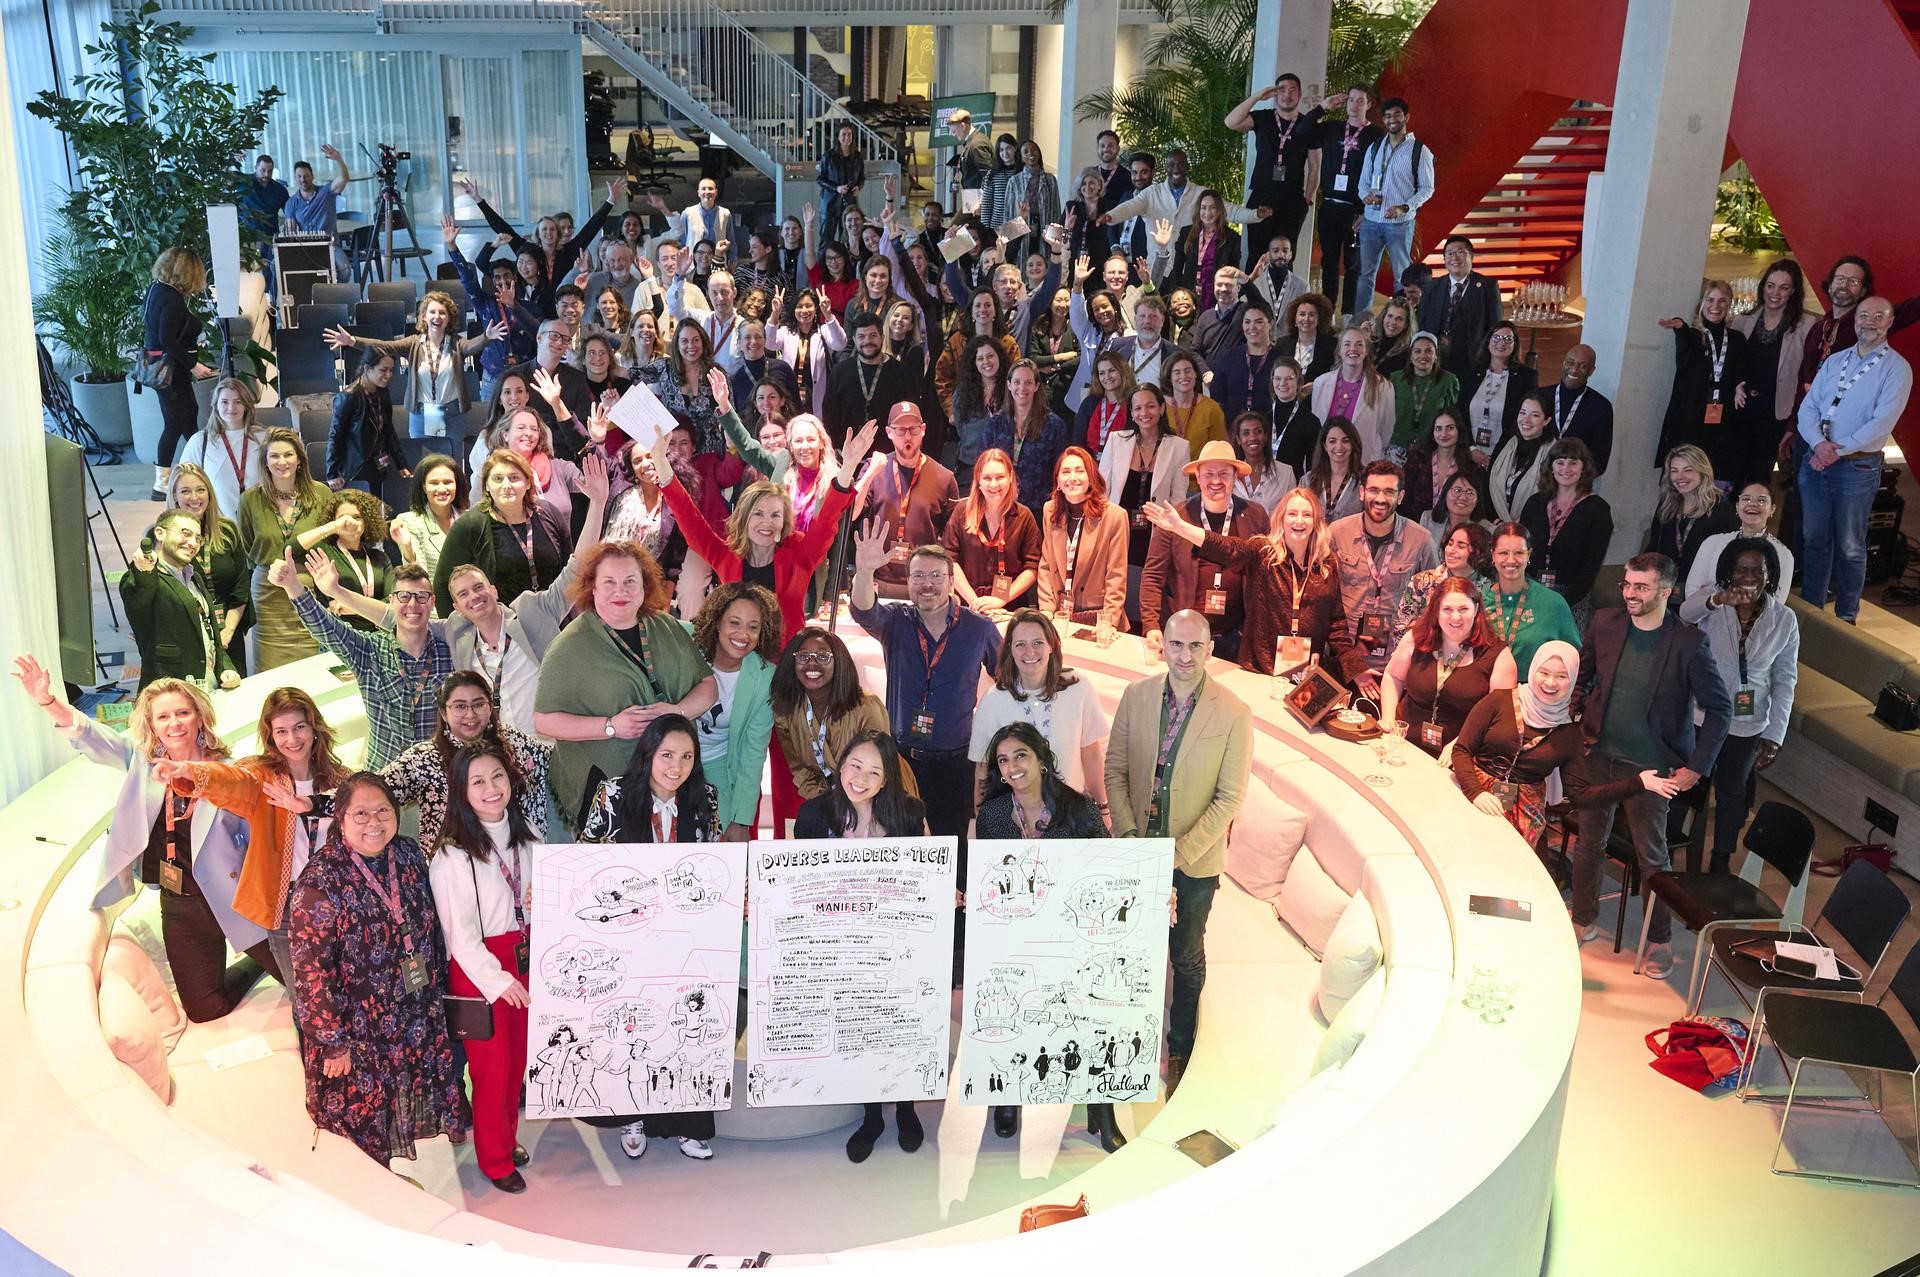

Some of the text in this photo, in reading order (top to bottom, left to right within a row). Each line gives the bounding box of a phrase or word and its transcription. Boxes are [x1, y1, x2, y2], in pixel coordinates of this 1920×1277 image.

[762, 850, 829, 869] DIVERSE
[835, 847, 900, 863] LEADERS
[910, 846, 949, 864] TECH
[1115, 878, 1141, 886] ELEPHANT
[816, 902, 874, 912] MANIFEST
[899, 911, 934, 920] CULTURAL
[989, 967, 1026, 976] TOGETHER
[1097, 1074, 1151, 1092] Flatland
